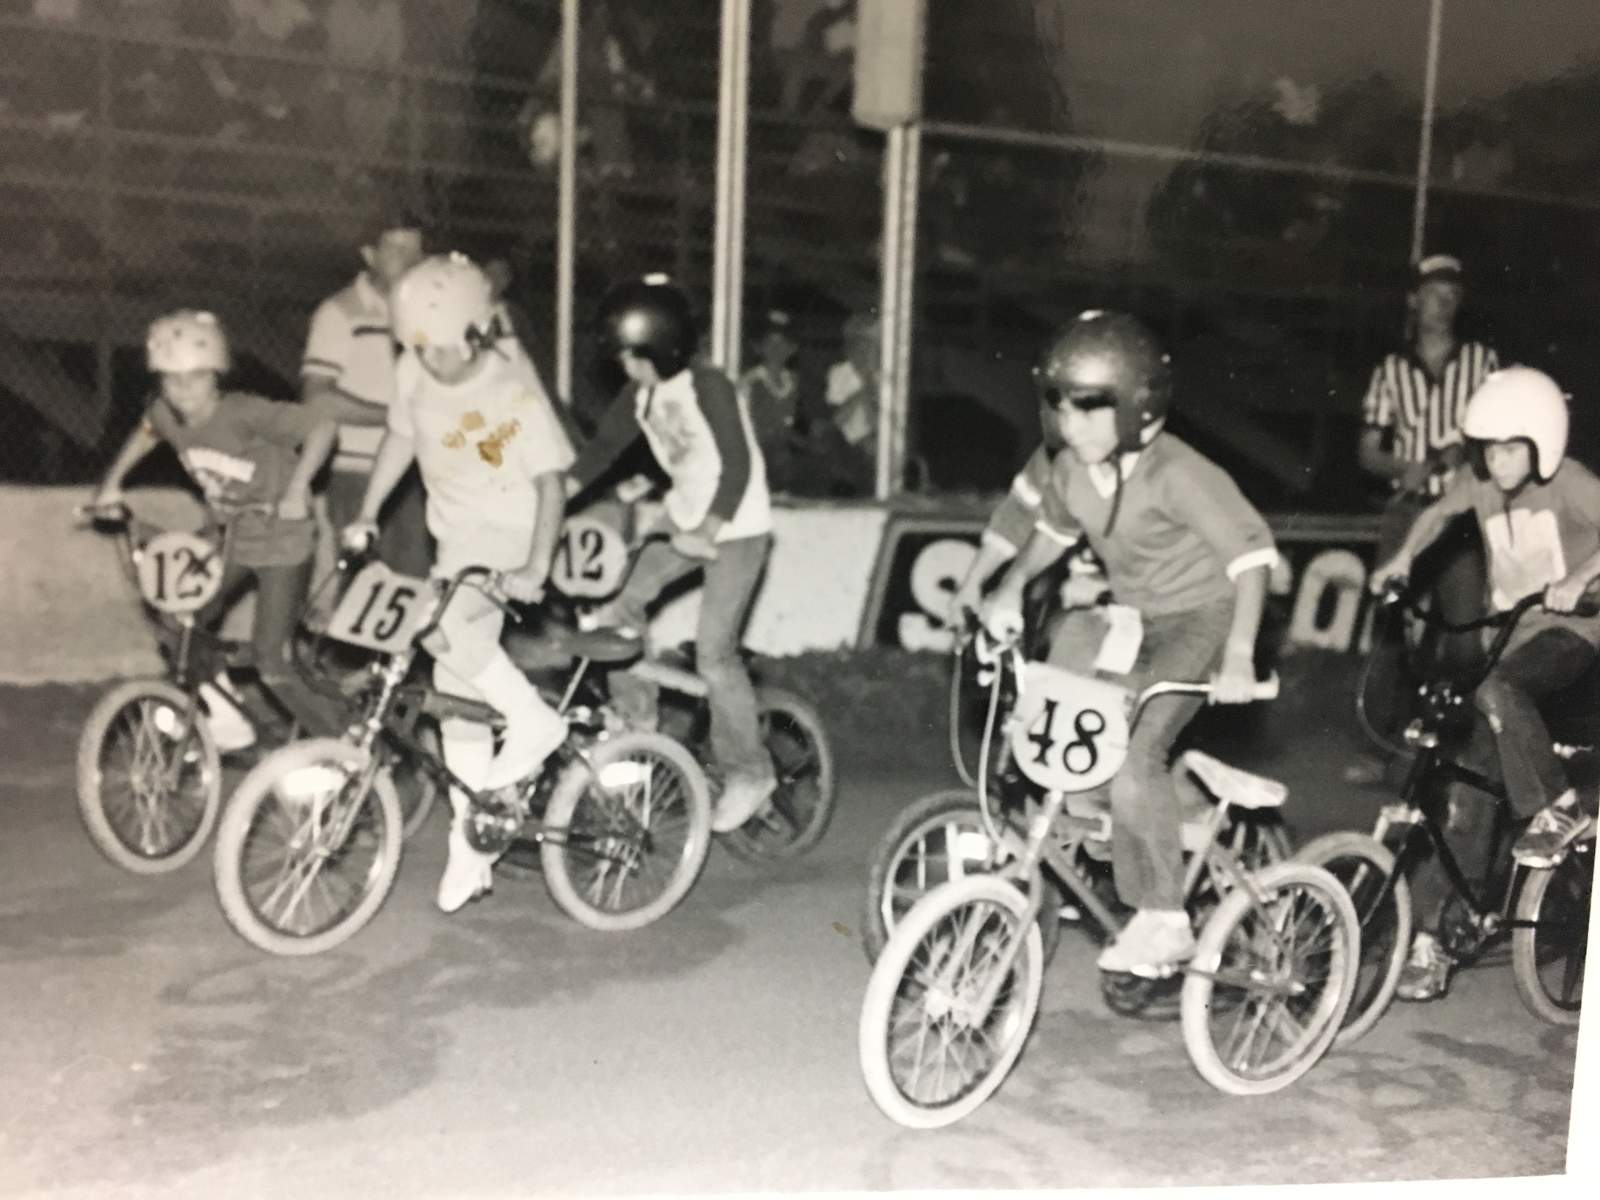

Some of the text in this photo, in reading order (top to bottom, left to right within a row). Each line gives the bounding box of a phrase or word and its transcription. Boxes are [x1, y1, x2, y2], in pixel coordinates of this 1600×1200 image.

[559, 528, 604, 581] 12
[349, 581, 416, 642] 15
[1026, 697, 1106, 775] 48
